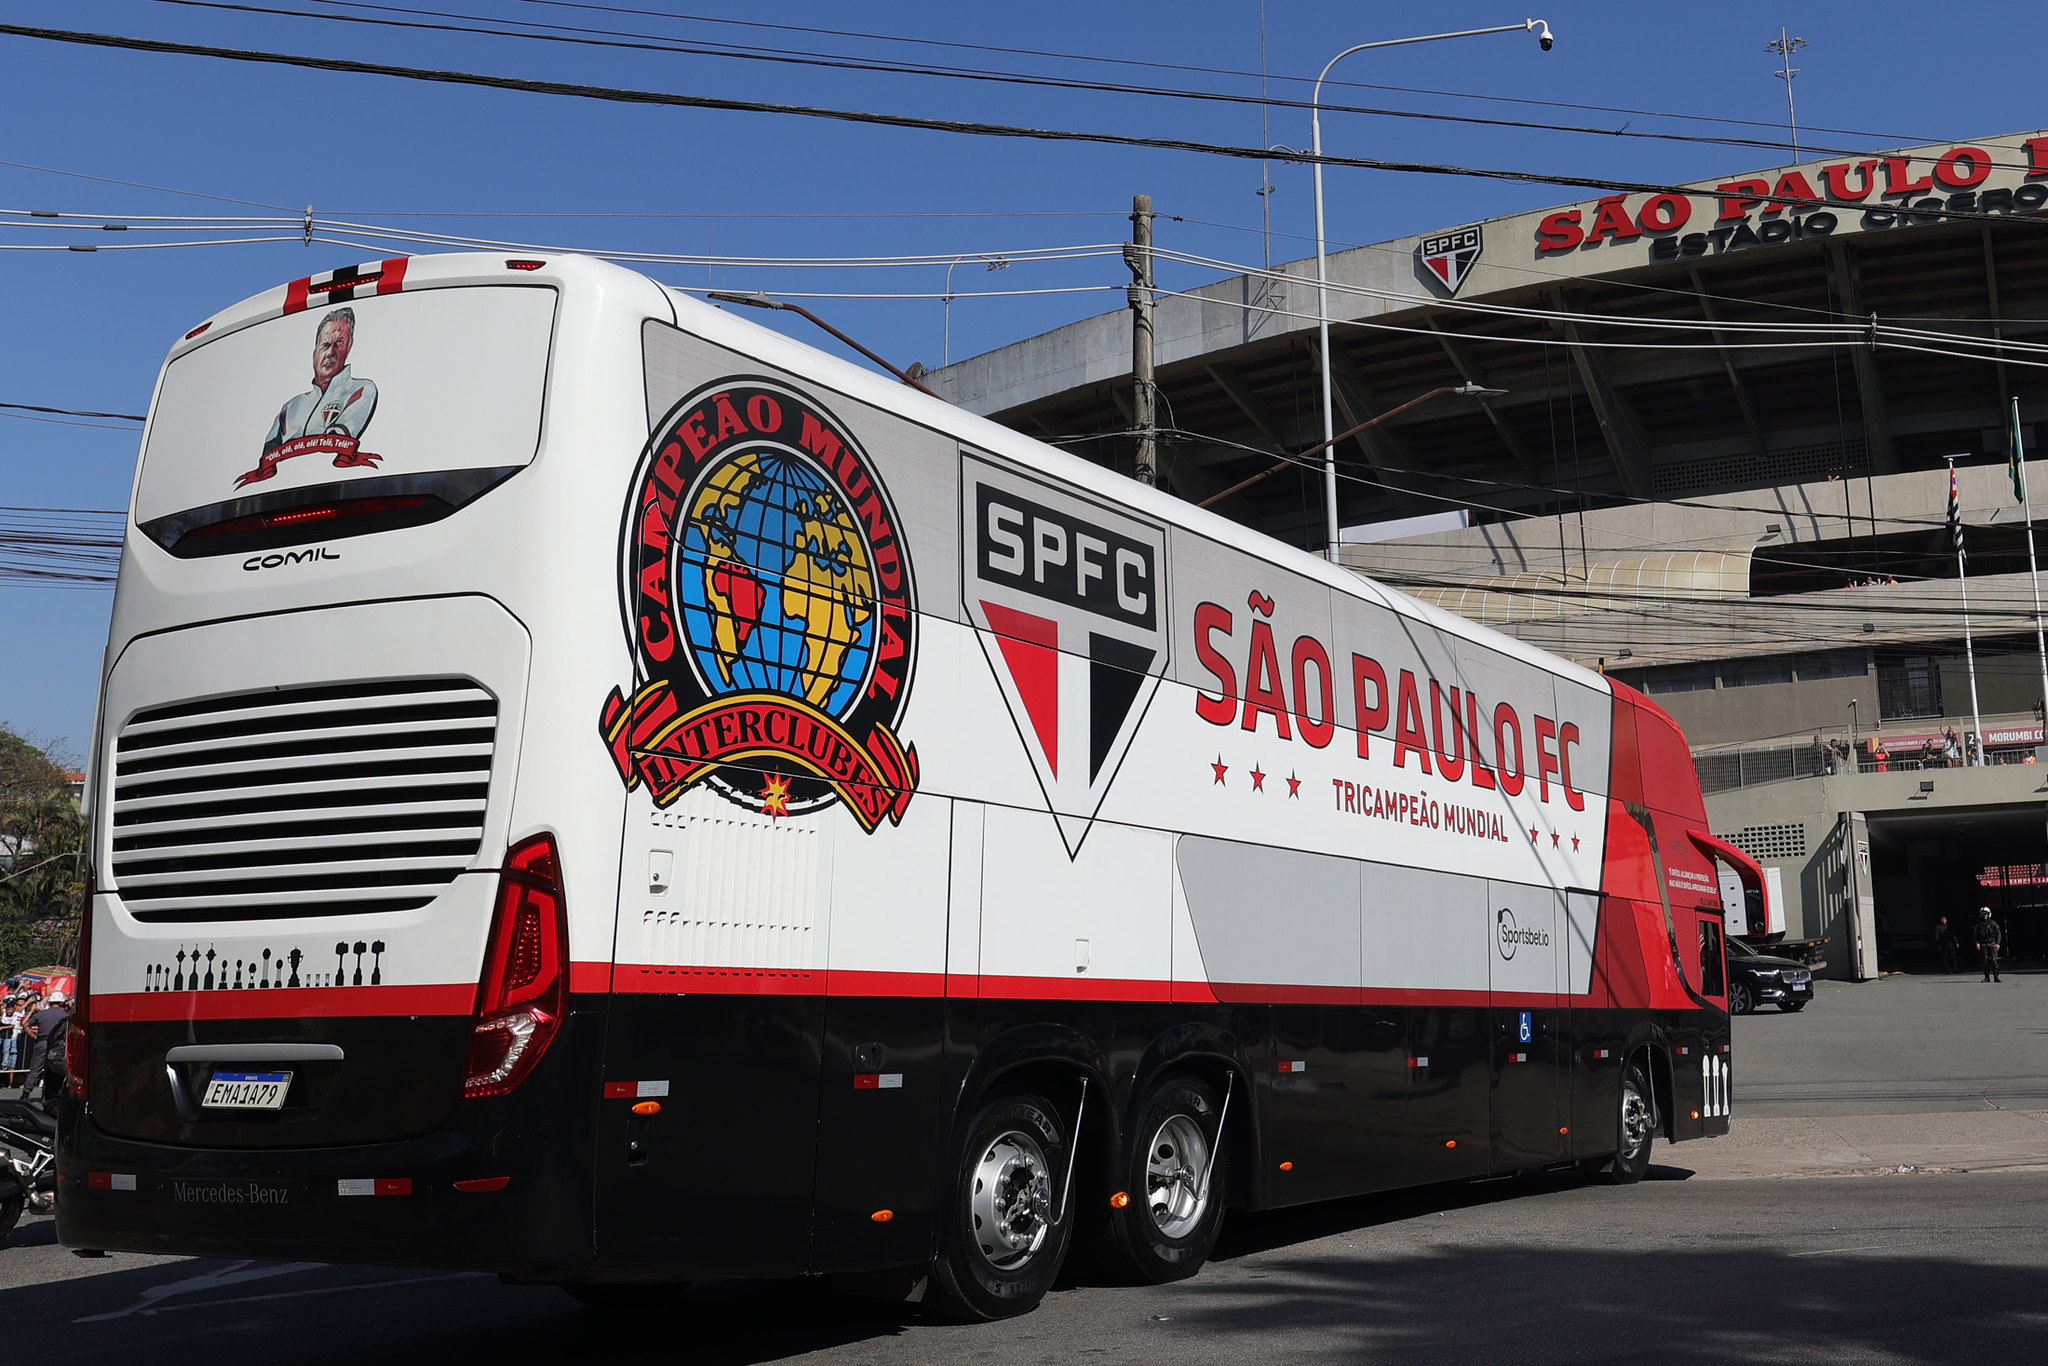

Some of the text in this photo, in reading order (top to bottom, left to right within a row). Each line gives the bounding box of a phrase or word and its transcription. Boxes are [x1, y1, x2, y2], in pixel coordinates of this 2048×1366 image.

[1540, 193, 1692, 250] SÃO
[1718, 146, 1992, 220] PAULO
[1426, 232, 1475, 255] SPFC
[1653, 211, 1838, 259] ESTÁDIO
[636, 393, 782, 662] CAMPEÃO
[798, 410, 906, 701] MUNDIAL
[242, 547, 341, 572] COMIL
[987, 501, 1148, 616] SPFC
[1194, 590, 1585, 812] SÃO PAULO FC
[646, 709, 890, 818] INTERCLUBES
[1988, 730, 2032, 743] MORUMBI
[1333, 778, 1508, 842] TRICAMPEÃO MUNDIAL
[1502, 924, 1549, 948] Sportsbet.io
[210, 1083, 278, 1105] EMA1A79
[174, 1182, 289, 1204] Mercedes-Benz
